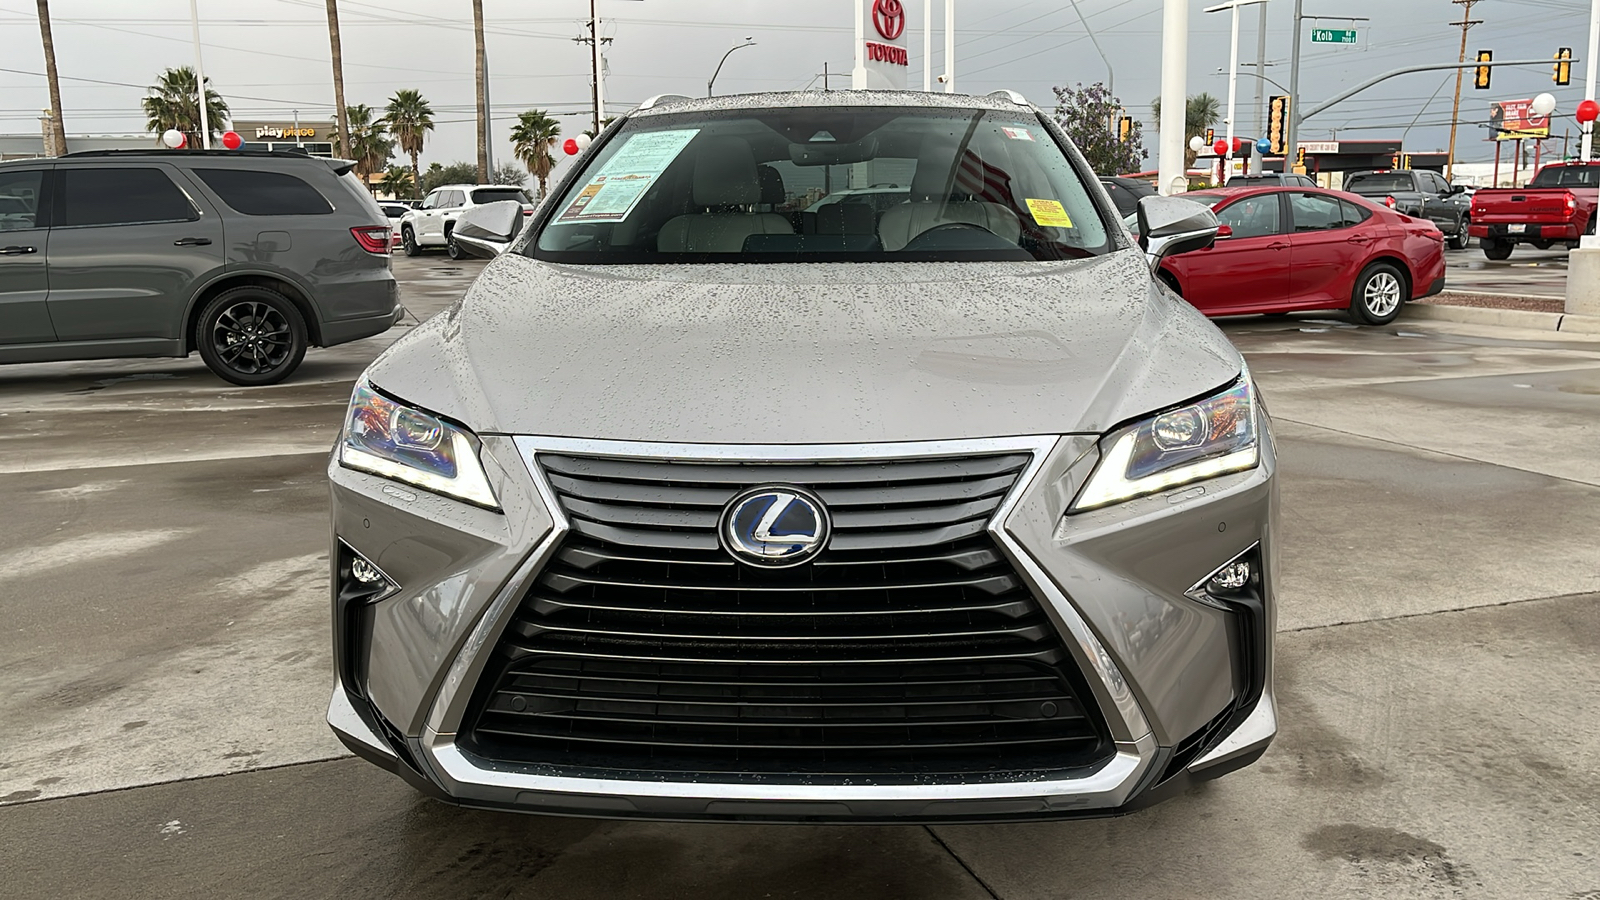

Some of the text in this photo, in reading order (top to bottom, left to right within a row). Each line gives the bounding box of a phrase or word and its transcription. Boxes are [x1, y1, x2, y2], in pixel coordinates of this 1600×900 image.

[1316, 30, 1333, 42] Kolb
[866, 42, 908, 66] TOYOTA
[255, 126, 315, 139] playplace
